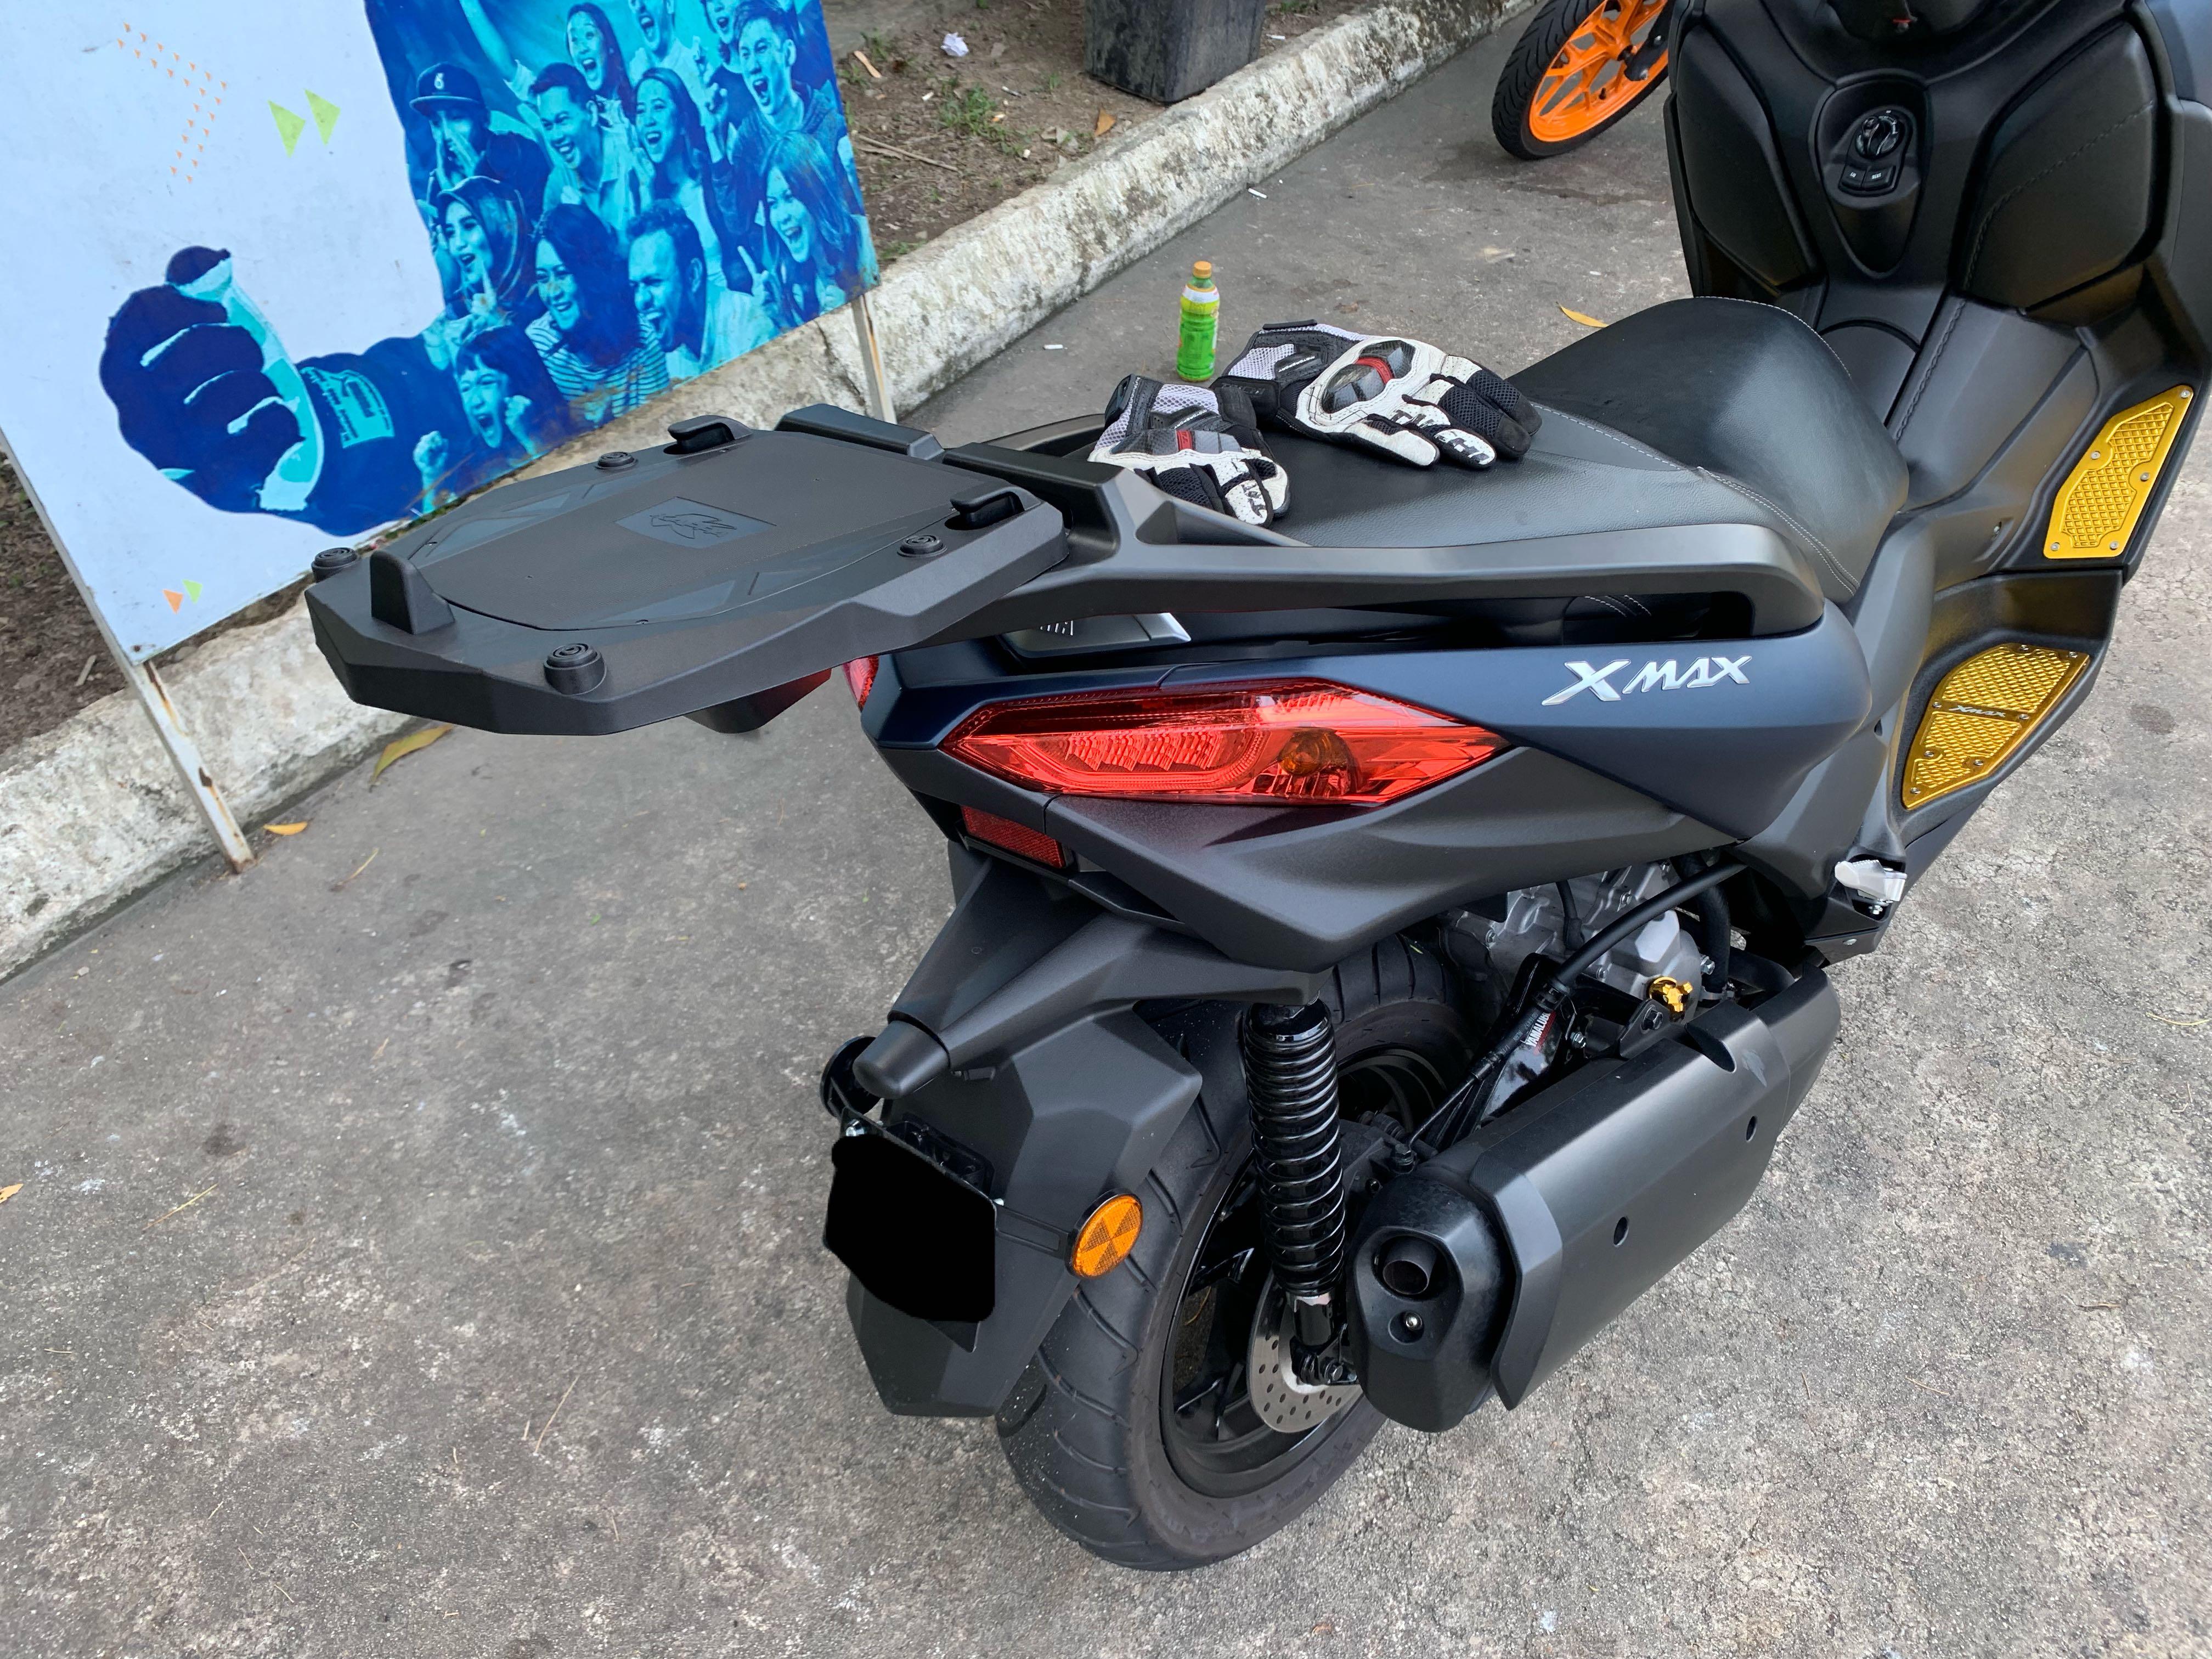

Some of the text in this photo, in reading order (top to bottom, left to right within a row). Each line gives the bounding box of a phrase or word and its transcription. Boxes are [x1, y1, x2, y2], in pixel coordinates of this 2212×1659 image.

[1278, 356, 1315, 373] MOTORSPORT
[1174, 409, 1207, 429] MOTORSPORT
[1541, 655, 1752, 706] XMAX
[1948, 705, 2006, 718] XMAX
